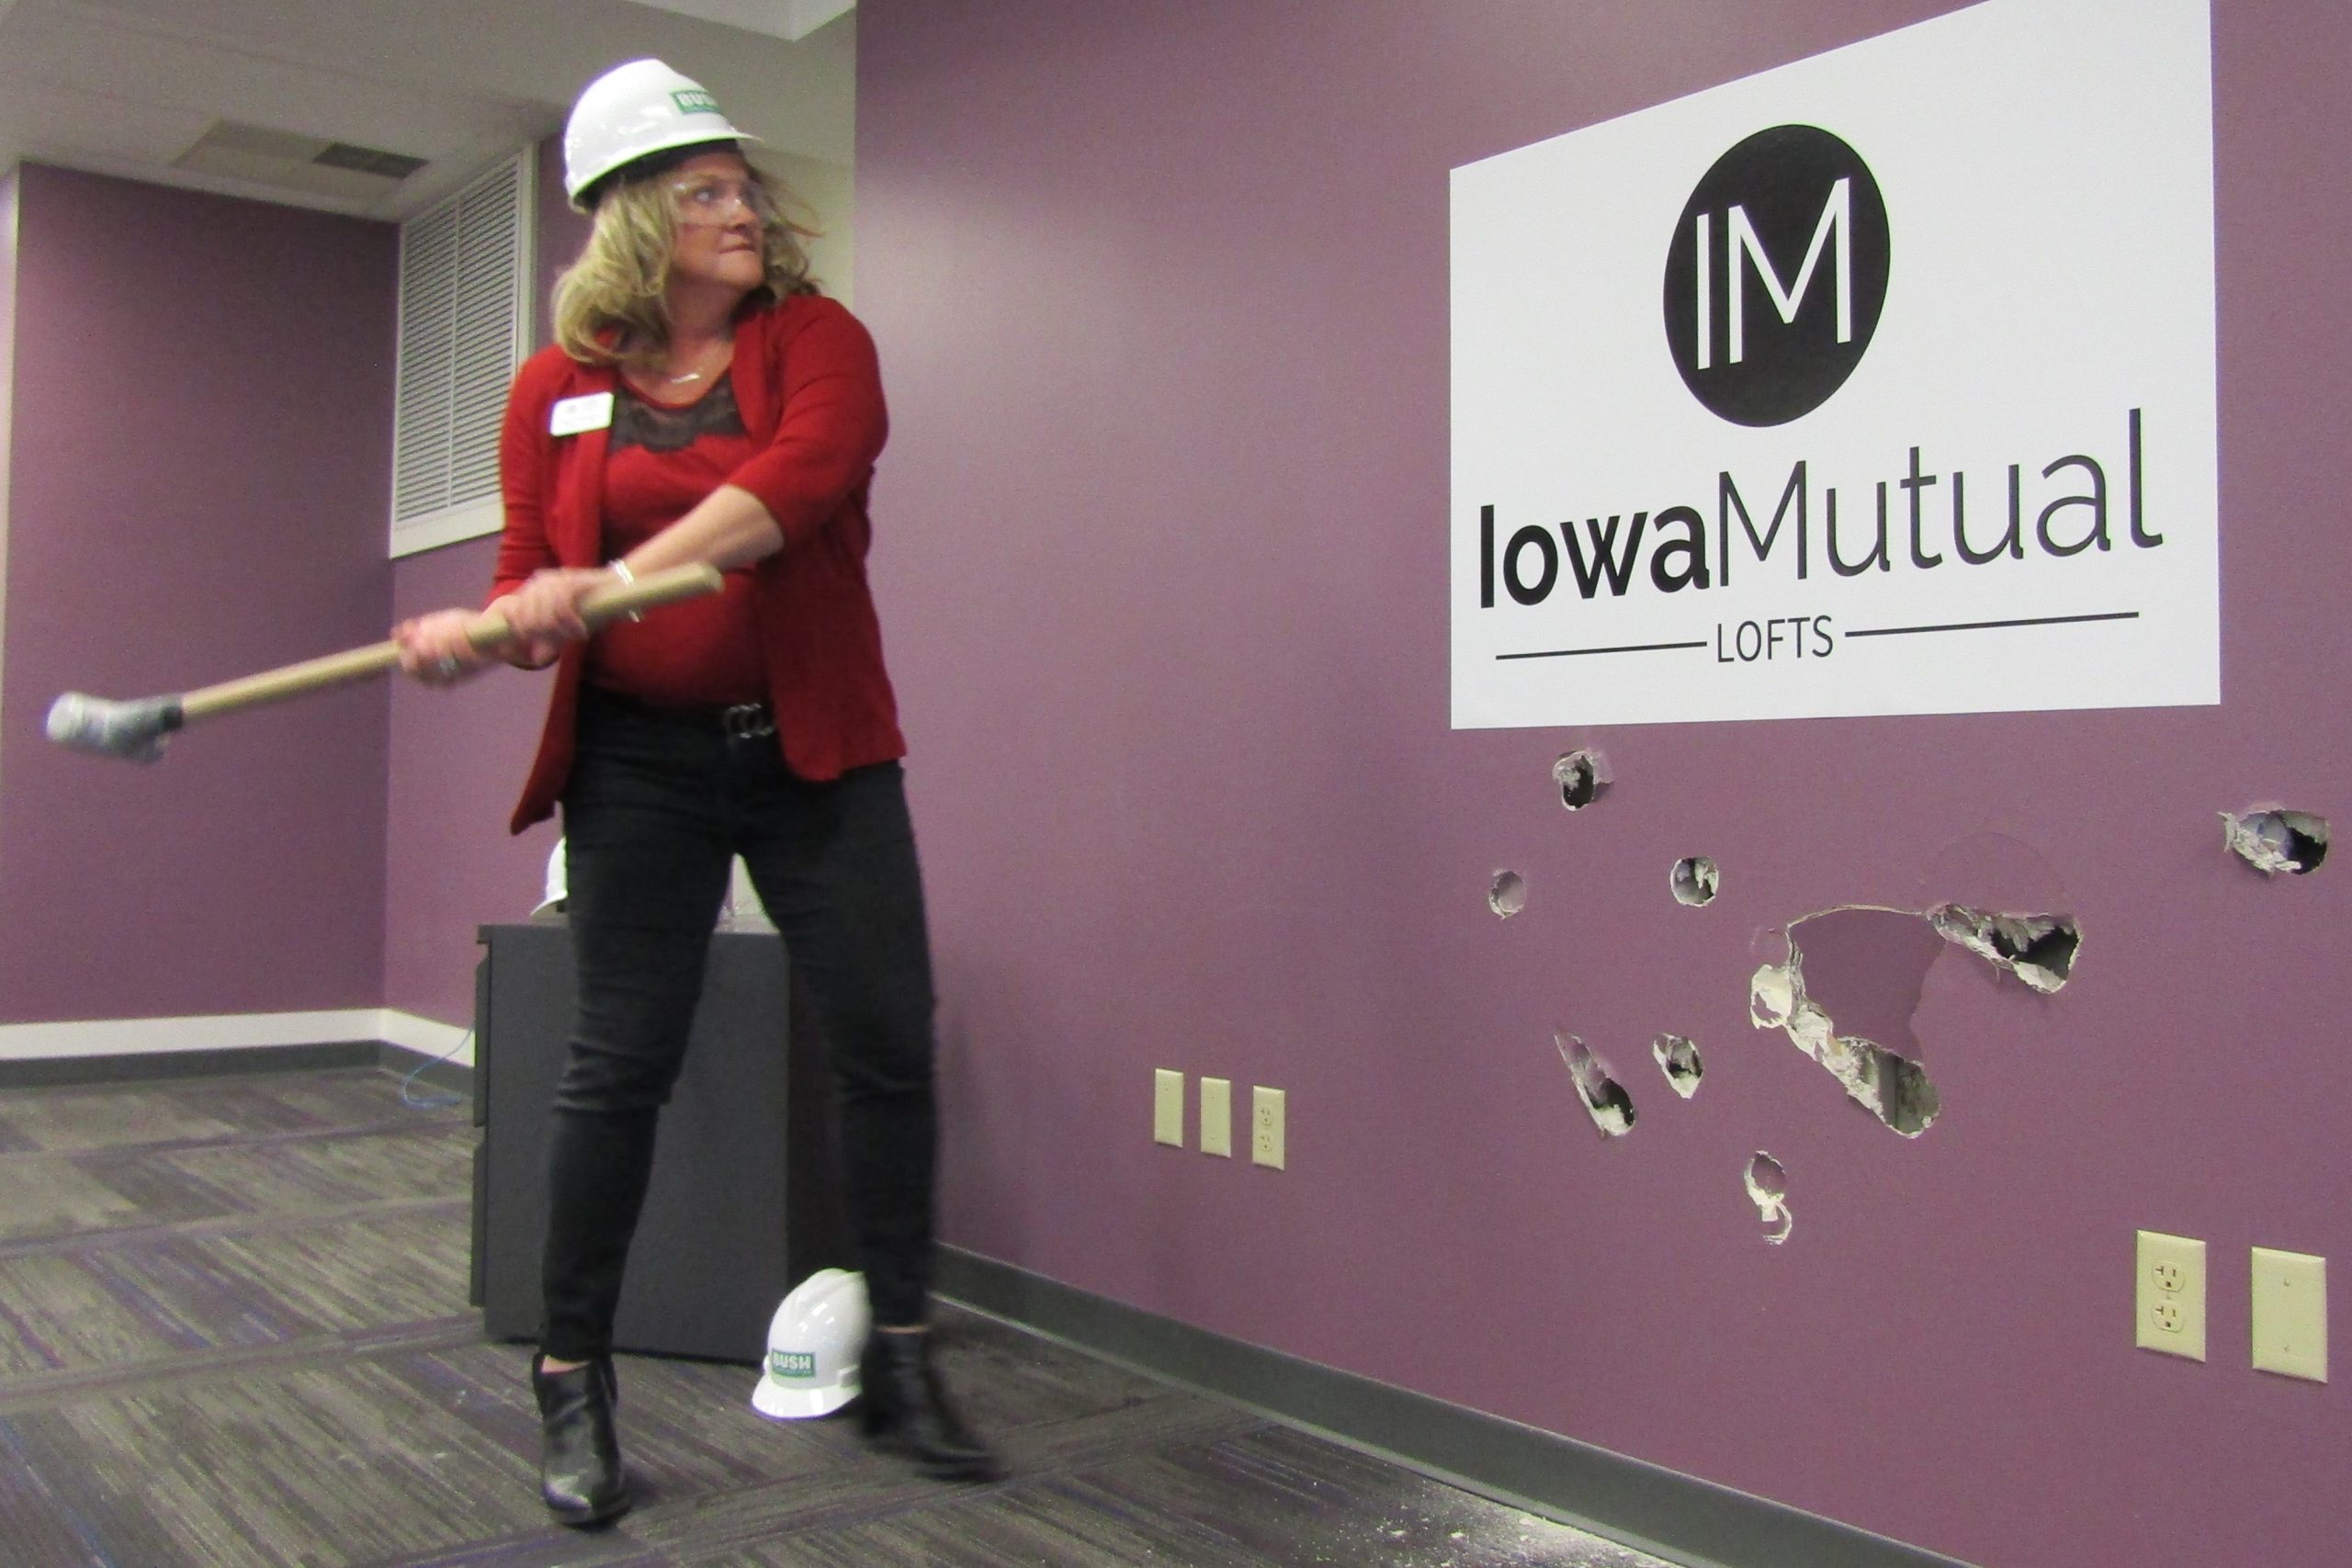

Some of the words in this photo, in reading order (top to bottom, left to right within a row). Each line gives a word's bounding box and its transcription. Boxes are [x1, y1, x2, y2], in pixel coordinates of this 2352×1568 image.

[1696, 177, 1851, 370] IM
[1717, 615, 1835, 663] LOFTS
[773, 1352, 811, 1370] BUSH
